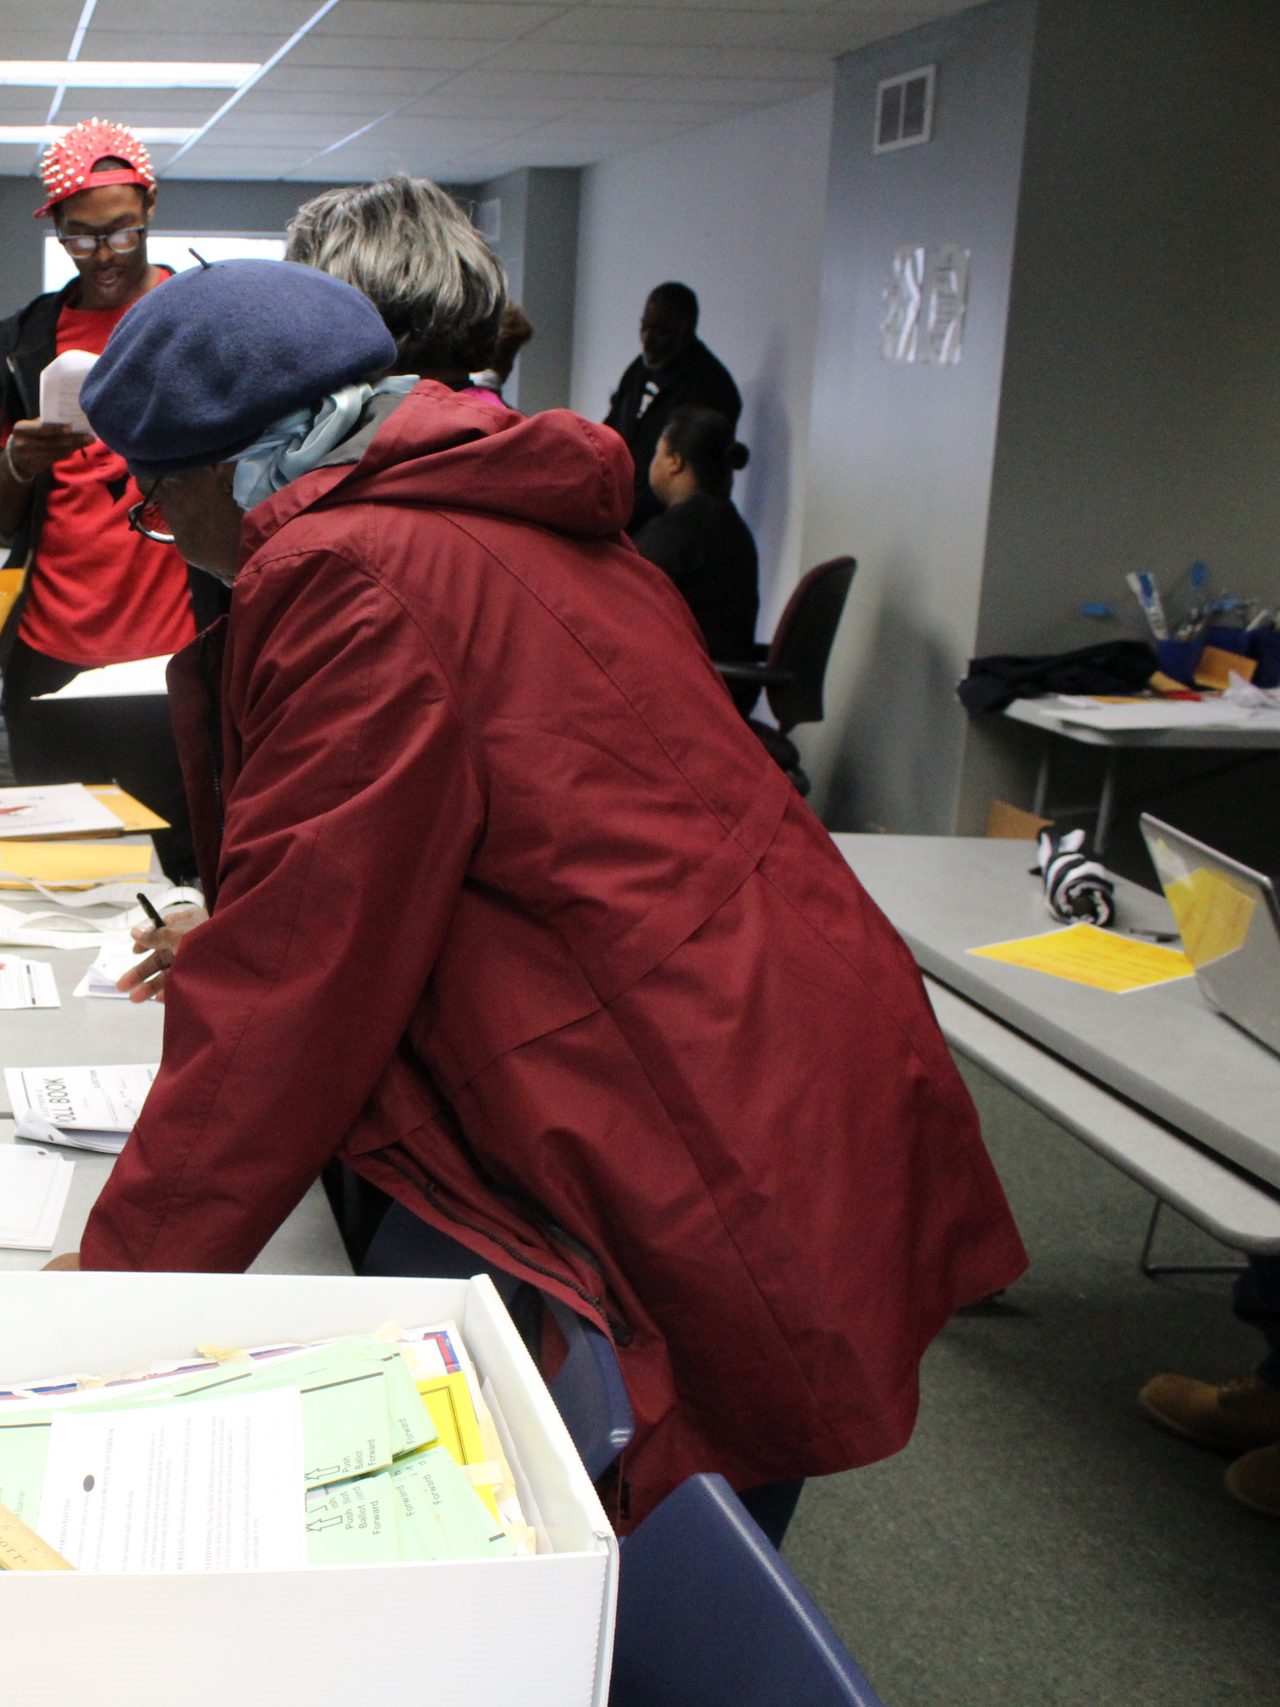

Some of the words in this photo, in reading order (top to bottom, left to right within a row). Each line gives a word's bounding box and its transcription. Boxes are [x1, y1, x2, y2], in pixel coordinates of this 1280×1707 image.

[42, 1077, 71, 1104] BOOK
[398, 1418, 416, 1445] Forward
[342, 1455, 351, 1473] Push
[354, 1449, 364, 1470] Ballot
[367, 1438, 376, 1466] Forward
[395, 1483, 415, 1518] Forward
[422, 1473, 442, 1506] Forward
[344, 1507, 354, 1530] Push
[358, 1503, 368, 1529] Ballot
[370, 1499, 382, 1535] Forward
